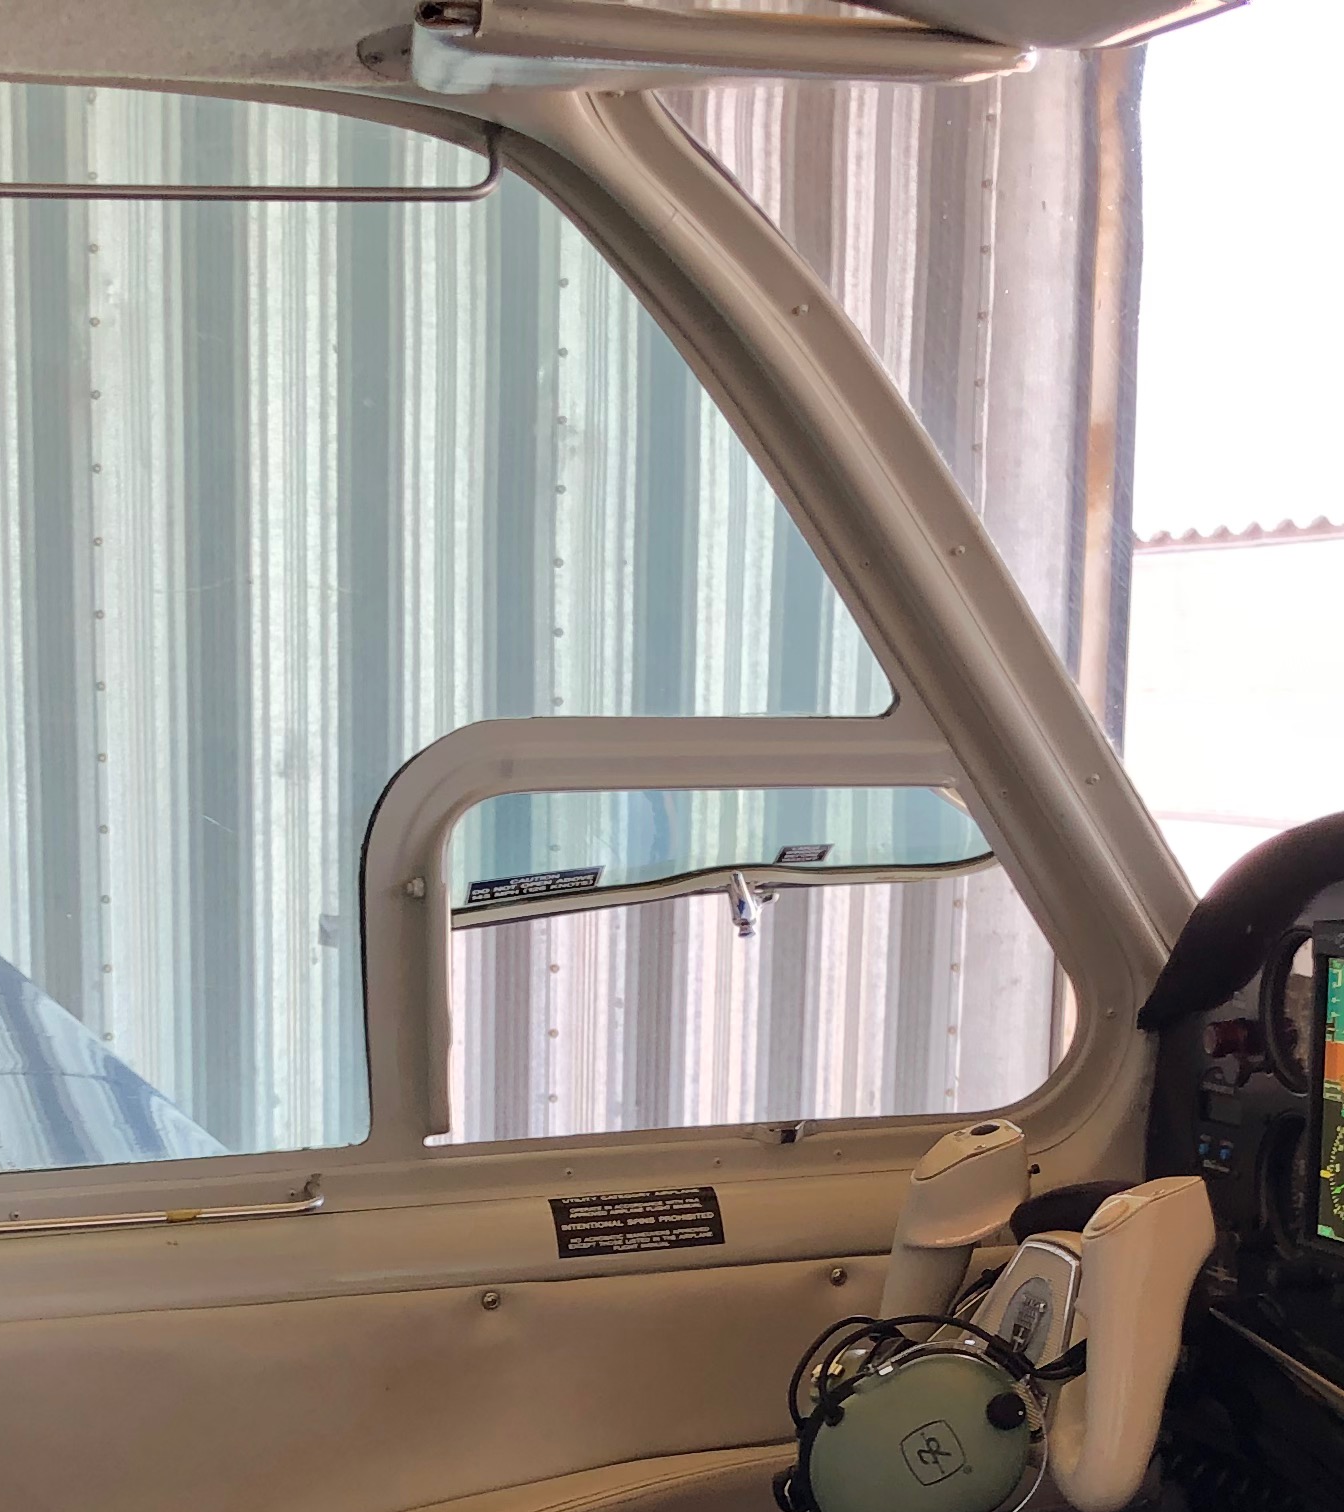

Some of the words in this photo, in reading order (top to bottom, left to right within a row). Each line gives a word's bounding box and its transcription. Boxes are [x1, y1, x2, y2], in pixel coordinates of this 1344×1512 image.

[493, 885, 517, 893] NOT
[520, 880, 552, 888] OPEN
[556, 875, 595, 883] ABOVE
[510, 874, 560, 885] CAUTION
[561, 1220, 624, 1231] INTENTIONAL
[658, 1212, 715, 1223] PROHIBITED
